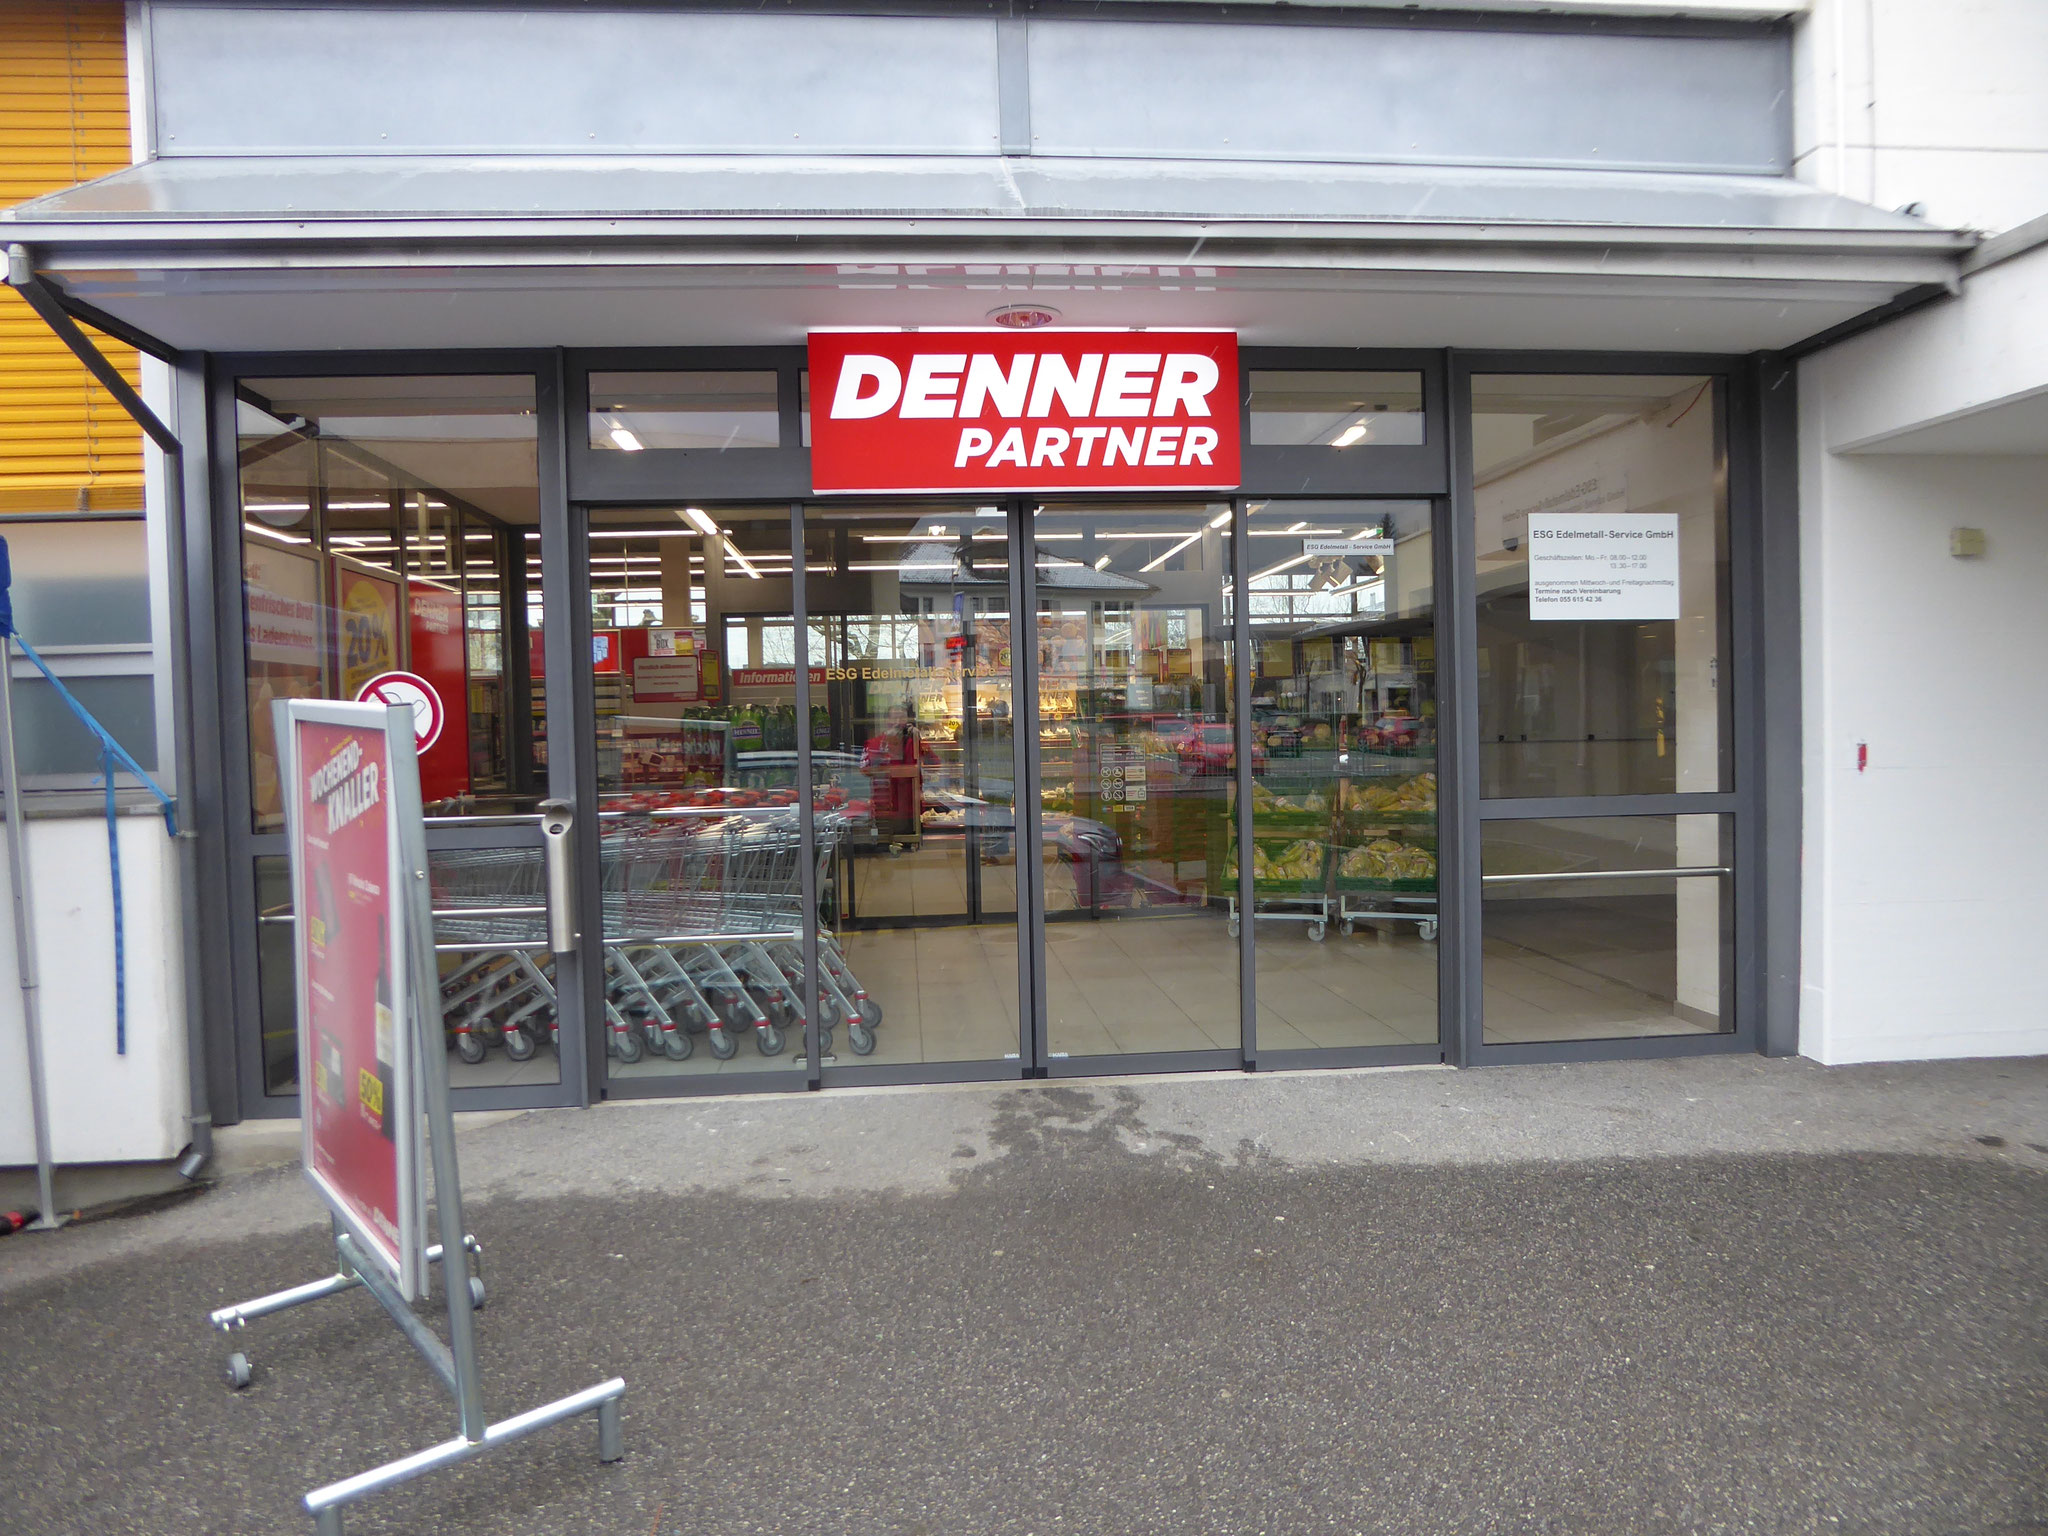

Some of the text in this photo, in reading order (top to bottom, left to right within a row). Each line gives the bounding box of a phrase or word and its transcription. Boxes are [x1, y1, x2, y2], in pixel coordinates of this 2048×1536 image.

[830, 353, 1220, 419] DENNER
[954, 426, 1219, 468] PARTNER
[1533, 530, 1554, 539] ESG
[1645, 530, 1674, 539] GmbH
[740, 671, 821, 684] Informatien
[825, 667, 858, 681] ESG
[328, 762, 380, 835] KNALLER
